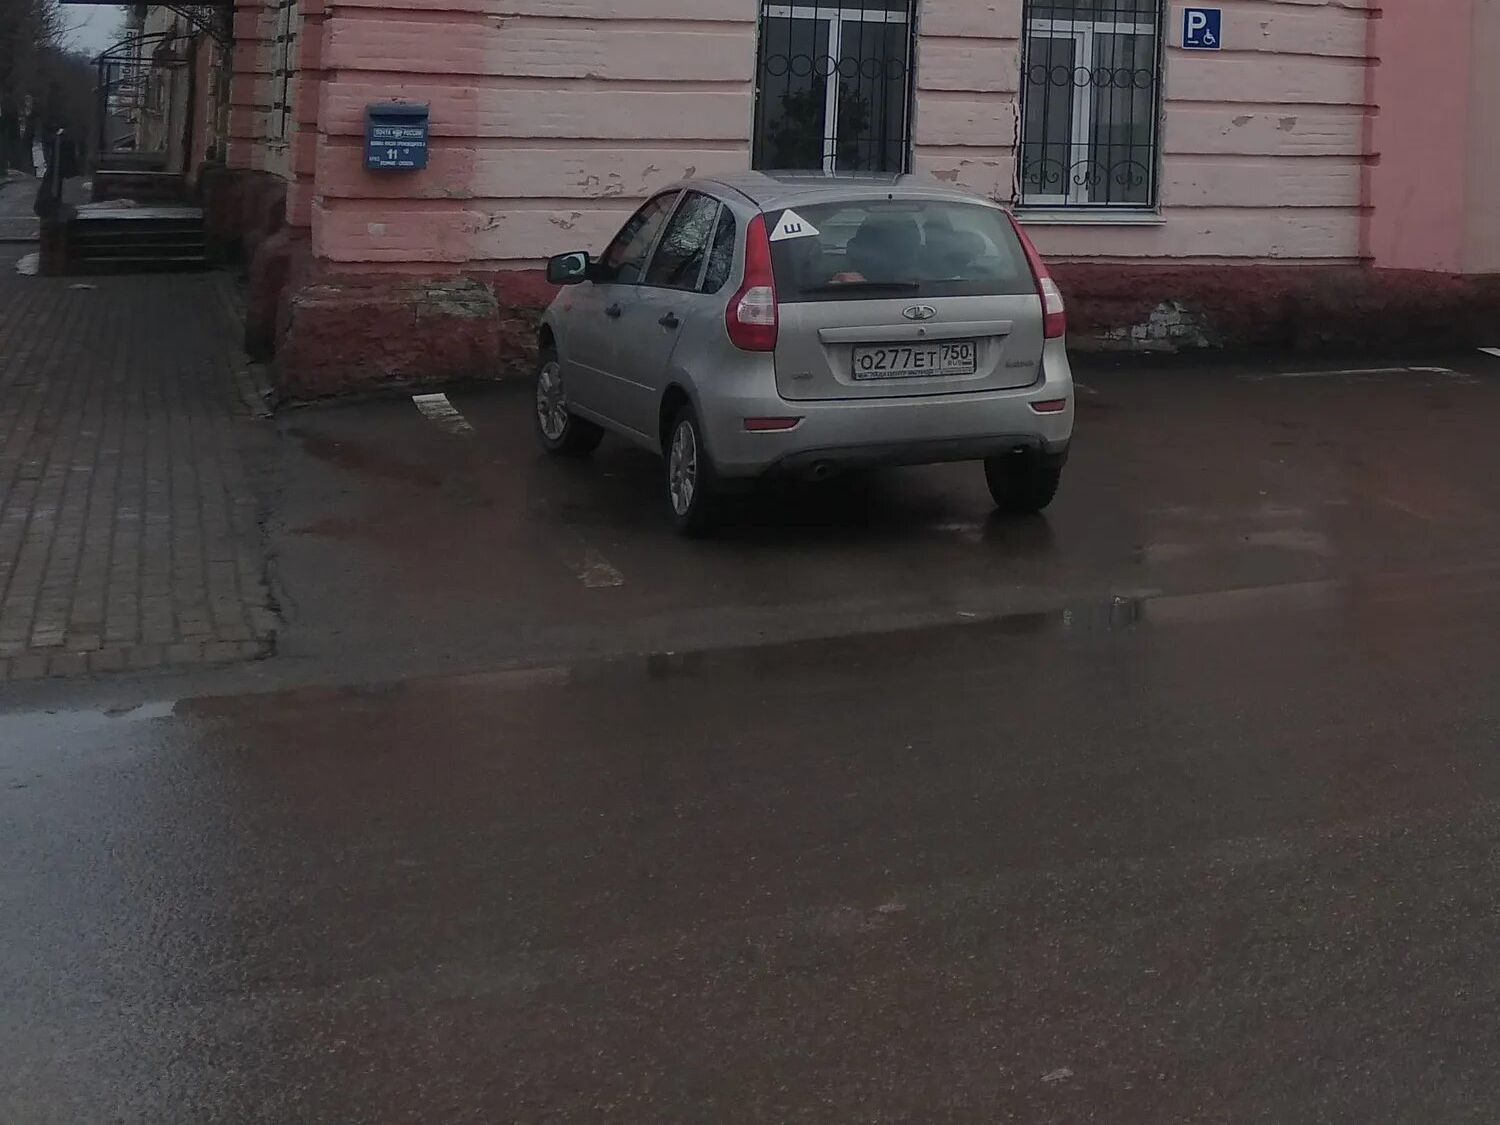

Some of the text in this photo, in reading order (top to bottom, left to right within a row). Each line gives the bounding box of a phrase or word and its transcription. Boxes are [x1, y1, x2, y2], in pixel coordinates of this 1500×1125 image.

[1187, 11, 1207, 38] P
[386, 148, 398, 159] 11
[784, 223, 802, 234] Ш
[861, 344, 969, 370] О277ЕТ 750
